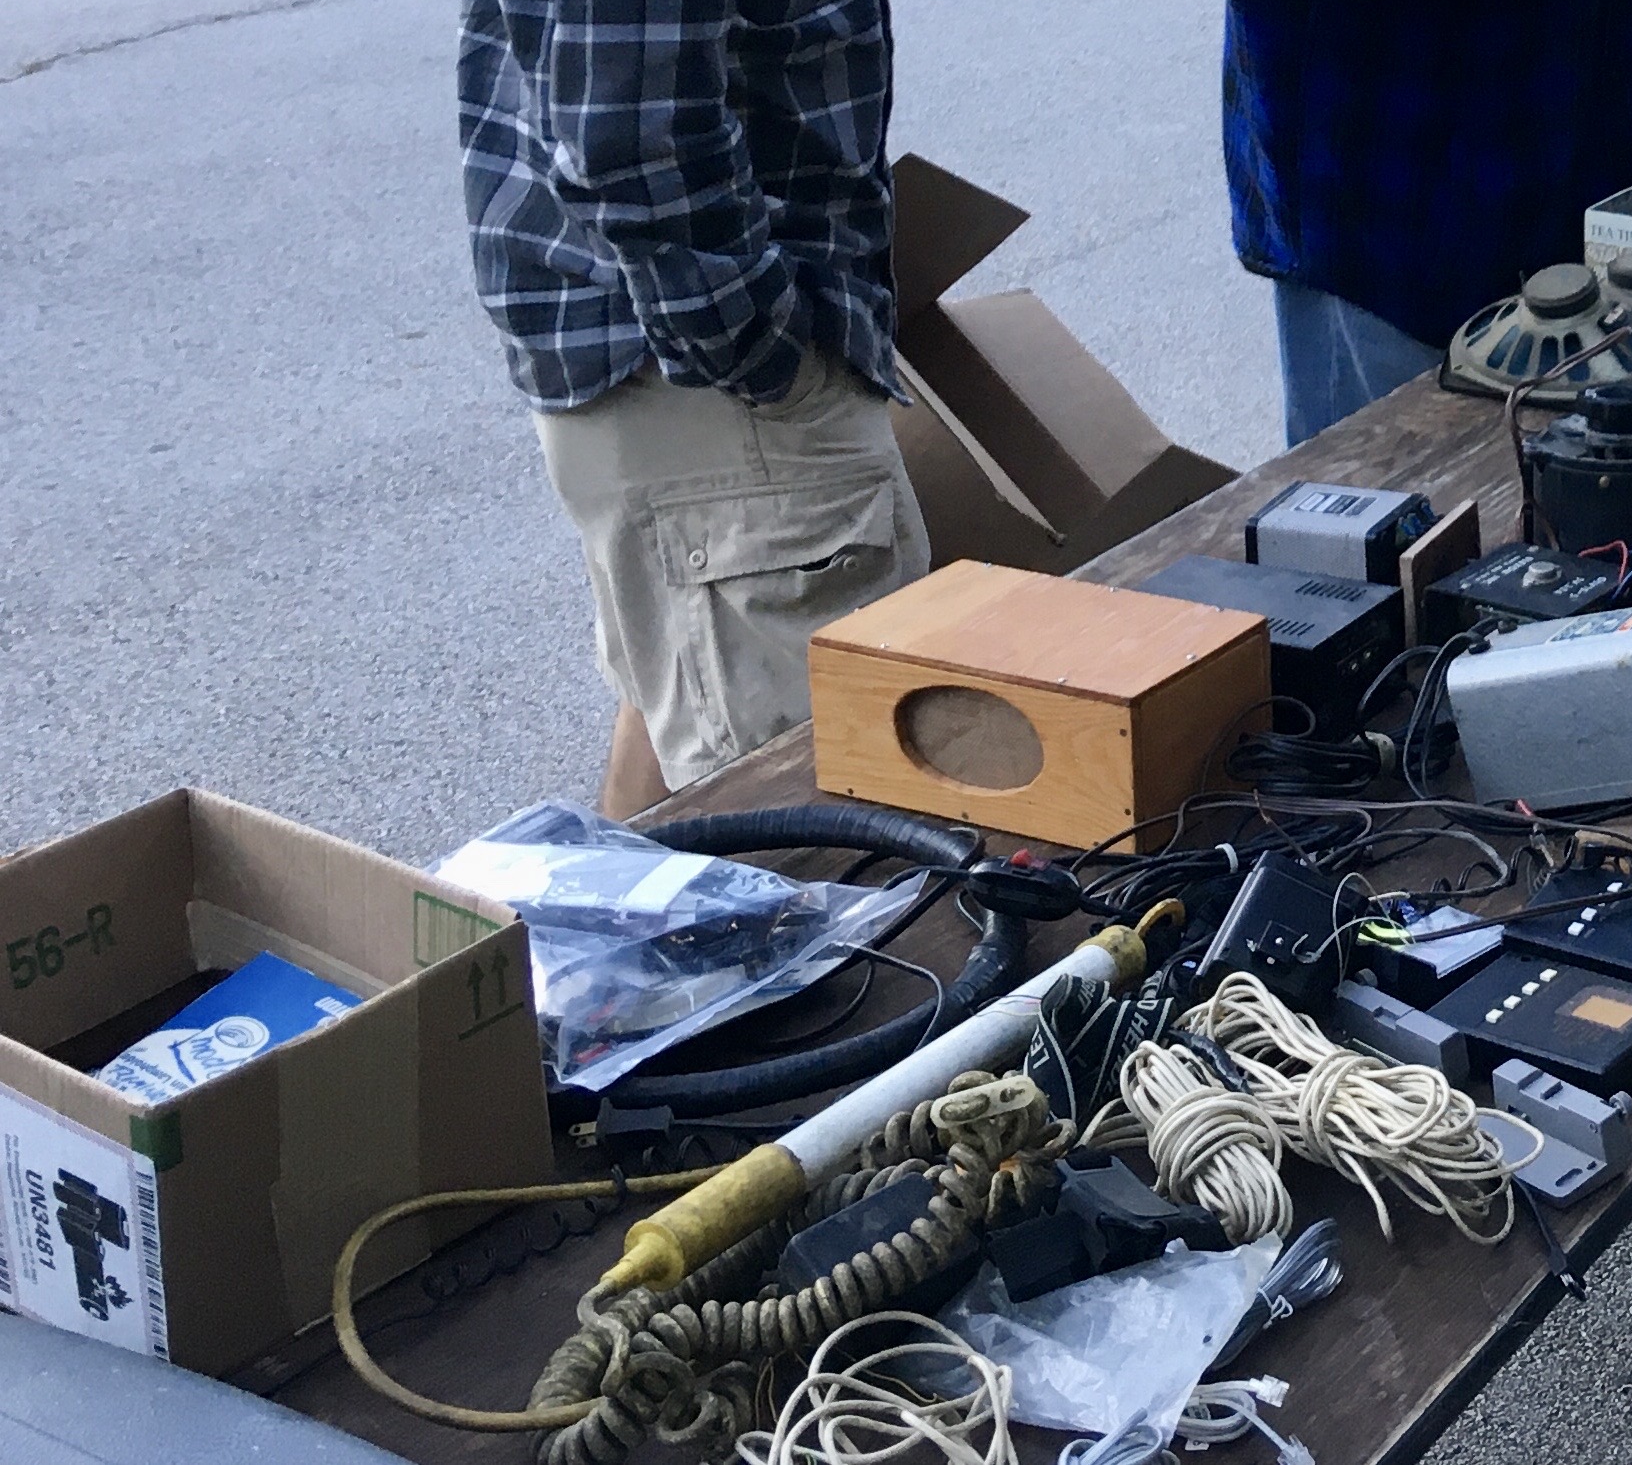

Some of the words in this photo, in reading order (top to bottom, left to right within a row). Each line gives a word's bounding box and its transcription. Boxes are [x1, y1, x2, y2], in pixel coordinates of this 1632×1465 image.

[1591, 224, 1614, 240] TEA
[6, 904, 116, 990] 56-R
[25, 1168, 57, 1272] UN3481
